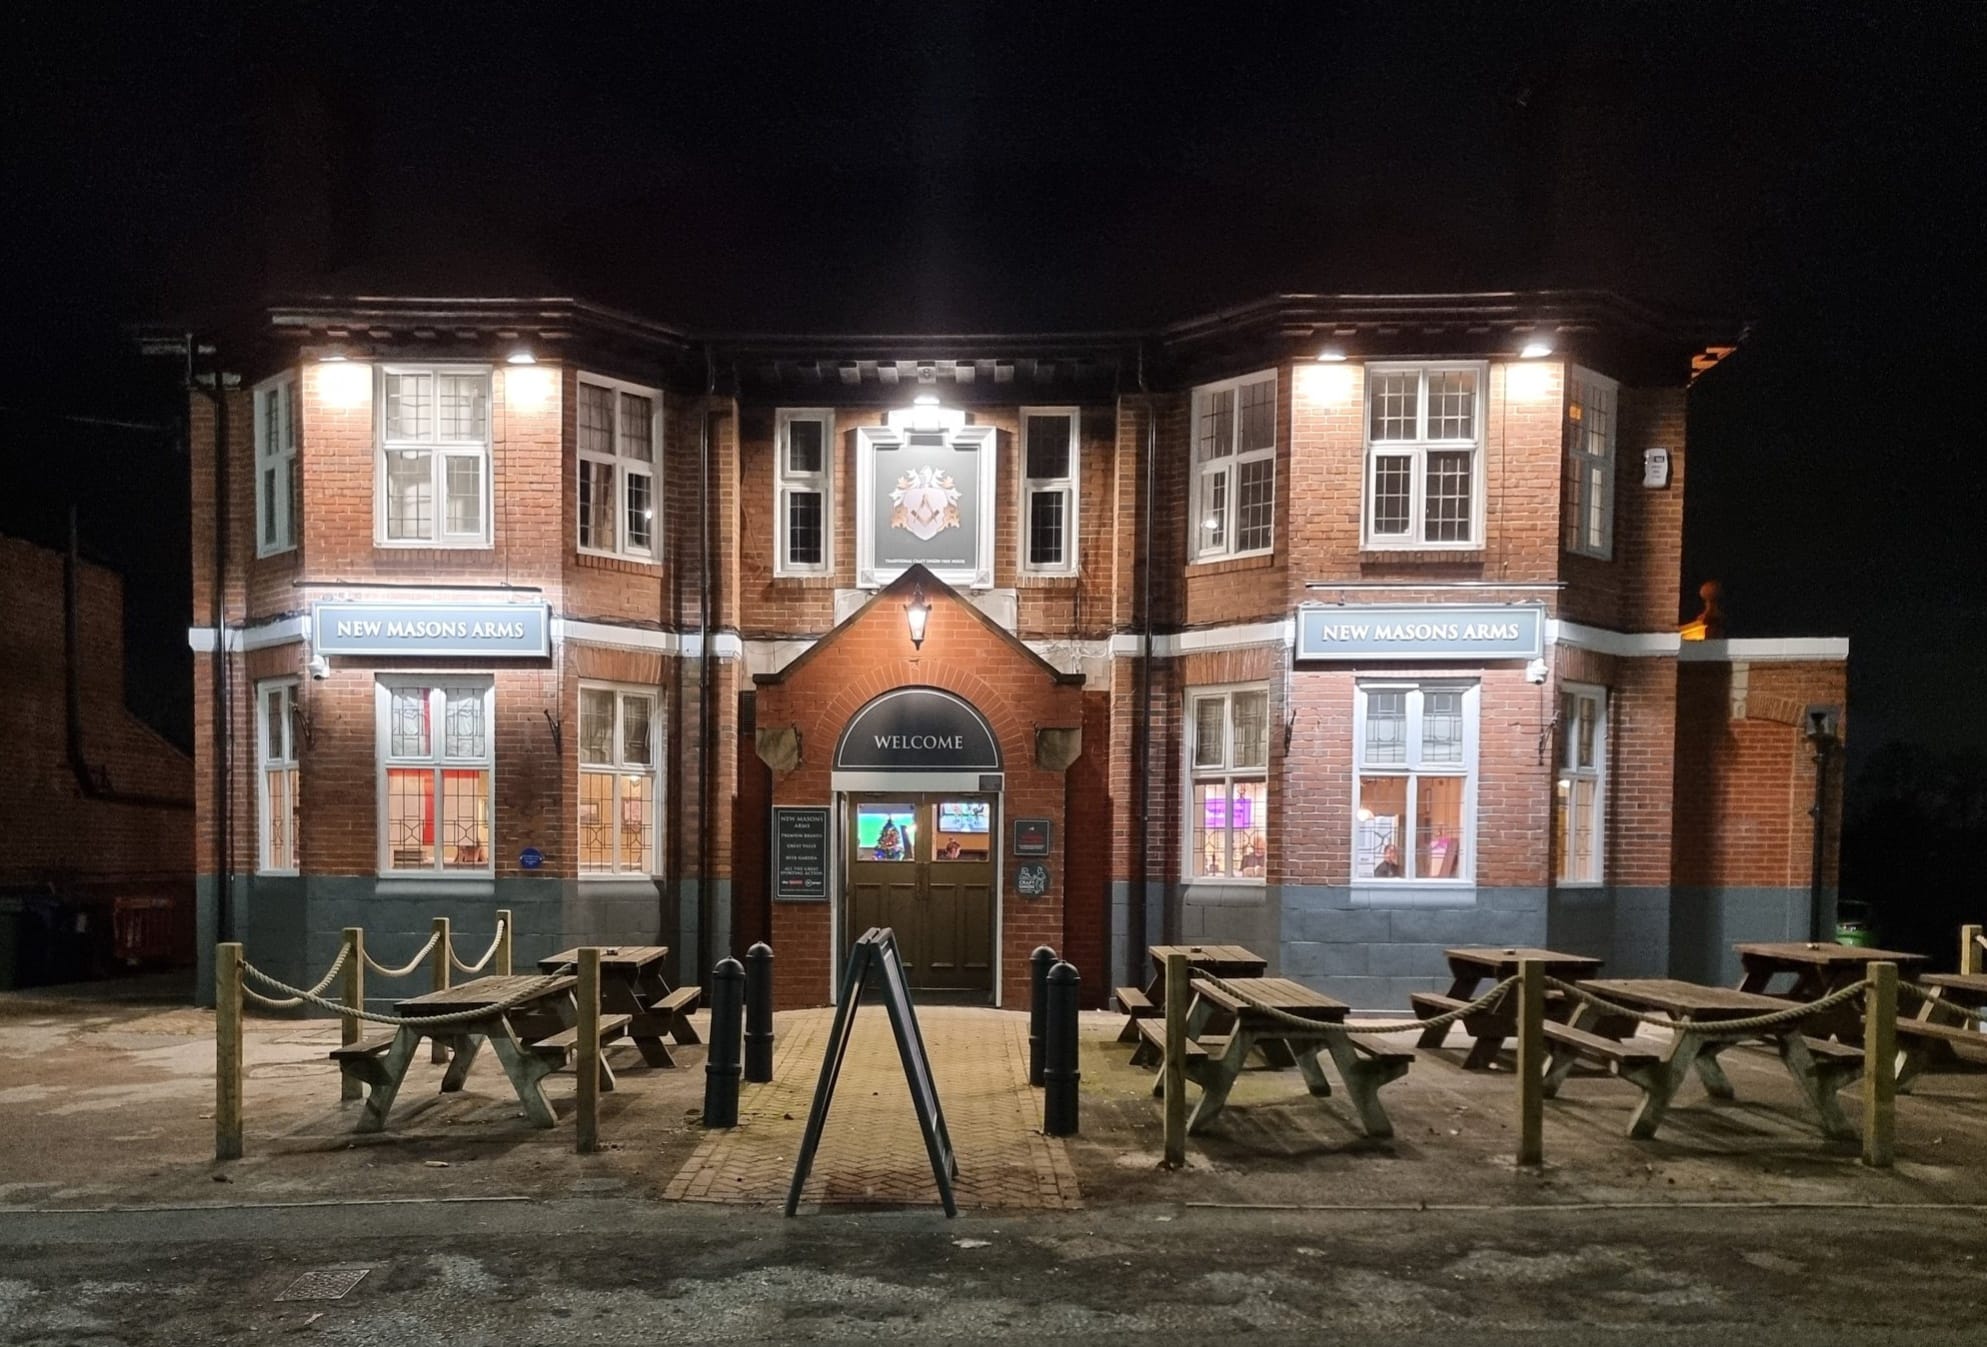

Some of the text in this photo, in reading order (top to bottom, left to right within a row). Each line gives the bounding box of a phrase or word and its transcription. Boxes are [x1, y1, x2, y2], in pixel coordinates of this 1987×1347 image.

[337, 620, 525, 639] NEW MASONS ARMS
[1322, 623, 1519, 642] NEW MASONS ARMS
[874, 735, 964, 749] WELCOME
